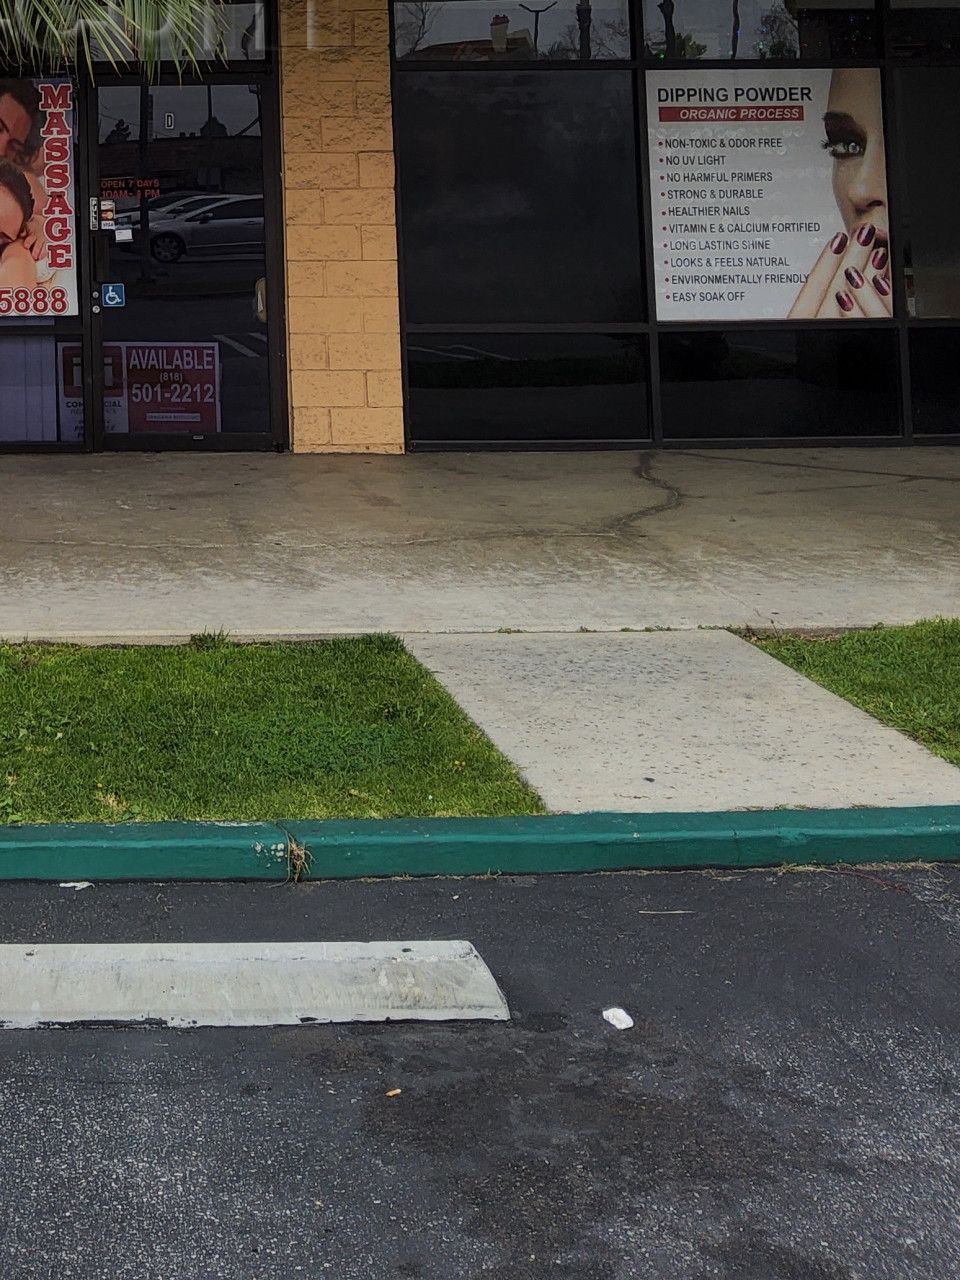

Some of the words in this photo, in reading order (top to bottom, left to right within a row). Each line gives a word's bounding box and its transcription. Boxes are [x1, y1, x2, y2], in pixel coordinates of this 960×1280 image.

[658, 87, 728, 102] DIPPING
[734, 87, 812, 101] POWDER
[679, 108, 737, 119] ORGANIC
[740, 108, 799, 118] PROCESS
[165, 113, 174, 129] D
[665, 138, 717, 148] NON-TOXIC
[719, 138, 726, 147] &
[728, 138, 756, 147] ODOR
[758, 138, 782, 147] FREE
[665, 156, 680, 165] NO
[682, 156, 695, 165] UV
[697, 155, 726, 165] LIGHT
[38, 83, 74, 269] MASSAGE
[666, 173, 681, 182] NO
[683, 173, 729, 182] HARMFUL
[731, 172, 773, 181] PRIMERS
[101, 180, 125, 188] OPEN
[128, 180, 134, 188] 7
[137, 179, 160, 187] DAYS
[145, 190, 160, 198] PM
[667, 189, 707, 199] STRONG
[710, 189, 717, 198] &
[718, 189, 764, 198] DURABLE
[668, 207, 720, 216] HEALTHIER
[722, 206, 750, 215] NAILS
[668, 224, 707, 233] VITAMIN
[709, 224, 716, 232] E
[718, 224, 725, 232] &
[727, 223, 770, 232] CALCIUM
[772, 223, 820, 232] FORTIFIED
[670, 241, 696, 250] LONG
[698, 241, 740, 249] LASTING
[741, 240, 770, 249] SHINE
[670, 258, 703, 267] LOOKS
[705, 258, 712, 267] &
[715, 258, 744, 267] FEELS
[746, 257, 790, 266] NATURAL
[672, 274, 763, 284] ENVIRONMENTALLY
[765, 274, 810, 283] FRIENDLY
[672, 292, 697, 301] EASY
[699, 291, 726, 301] SOAK
[727, 291, 745, 301] OFF
[129, 349, 214, 370] AVAILABLE
[159, 373, 183, 383] (818)
[131, 384, 215, 402] 501-2212
